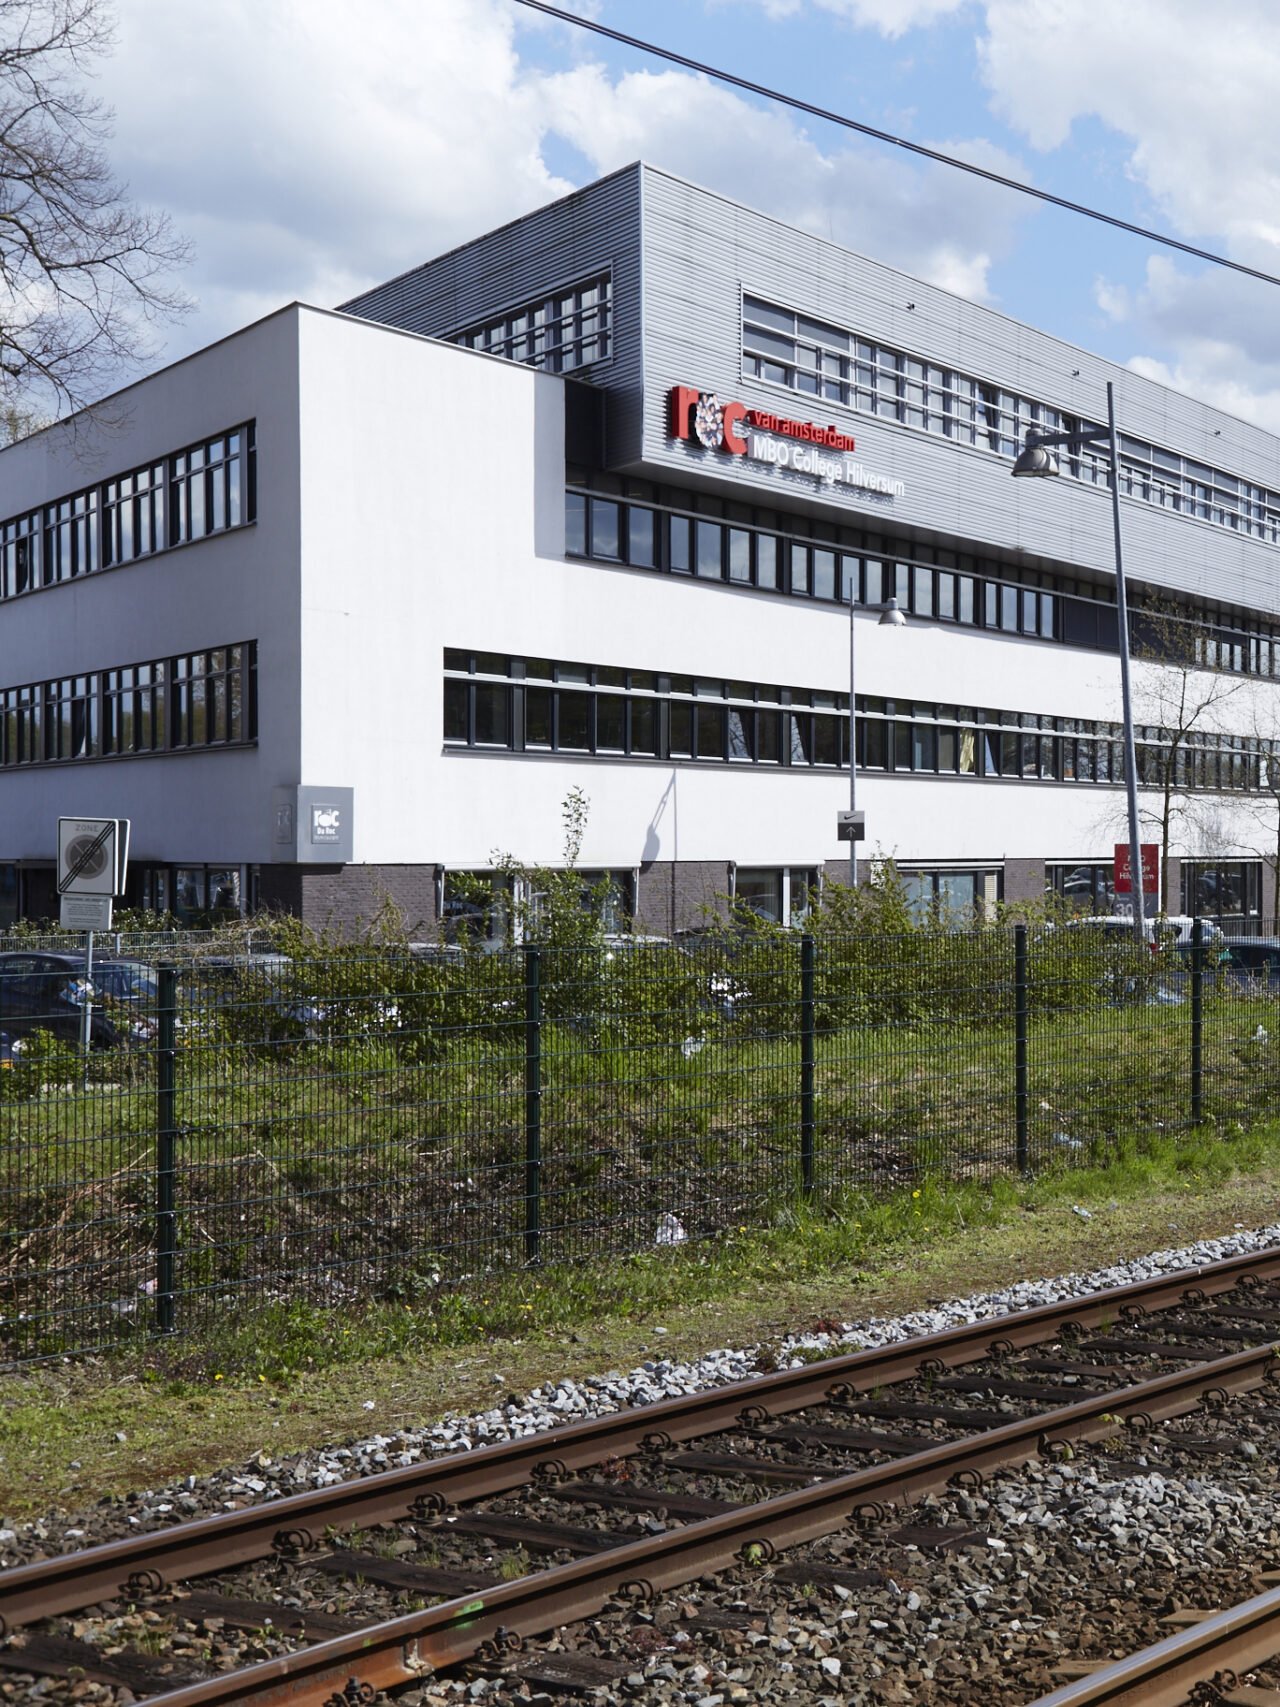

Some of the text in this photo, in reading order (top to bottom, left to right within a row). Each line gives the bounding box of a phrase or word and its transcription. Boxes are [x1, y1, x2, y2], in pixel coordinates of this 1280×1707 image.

[754, 411, 855, 452] van amsterdam
[753, 435, 905, 497] MBO College Hilversum
[75, 824, 99, 832] ZONE
